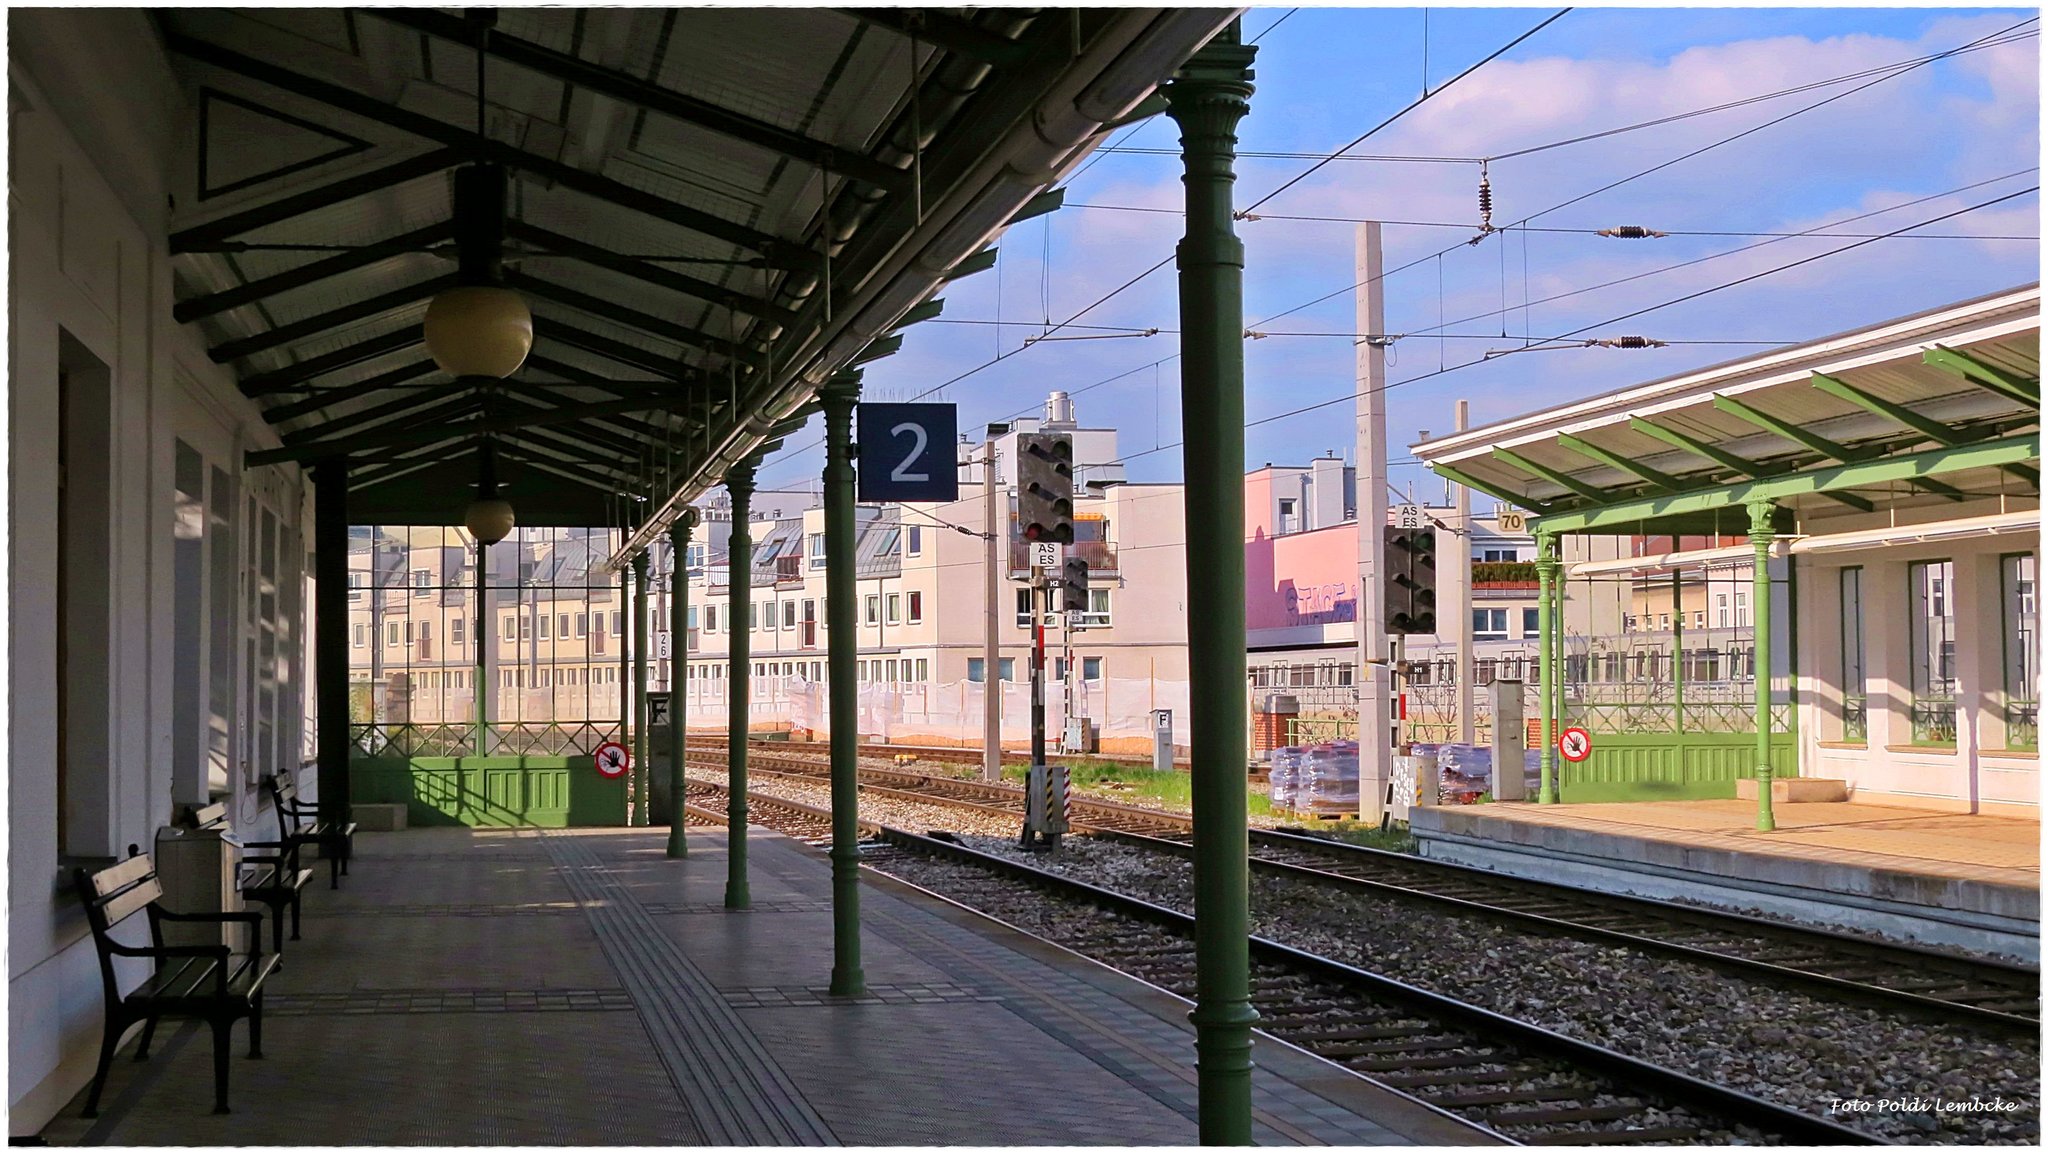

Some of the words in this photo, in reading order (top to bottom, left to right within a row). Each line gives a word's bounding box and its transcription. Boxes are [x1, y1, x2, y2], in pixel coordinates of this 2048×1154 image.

[890, 422, 929, 482] 2
[1401, 506, 1418, 516] AS
[1402, 517, 1418, 528] ES
[1502, 515, 1521, 529] 70
[1038, 543, 1055, 553] AS
[1039, 555, 1055, 565] ES
[660, 634, 667, 645] 2
[660, 646, 667, 656] 6
[1159, 713, 1167, 726] F
